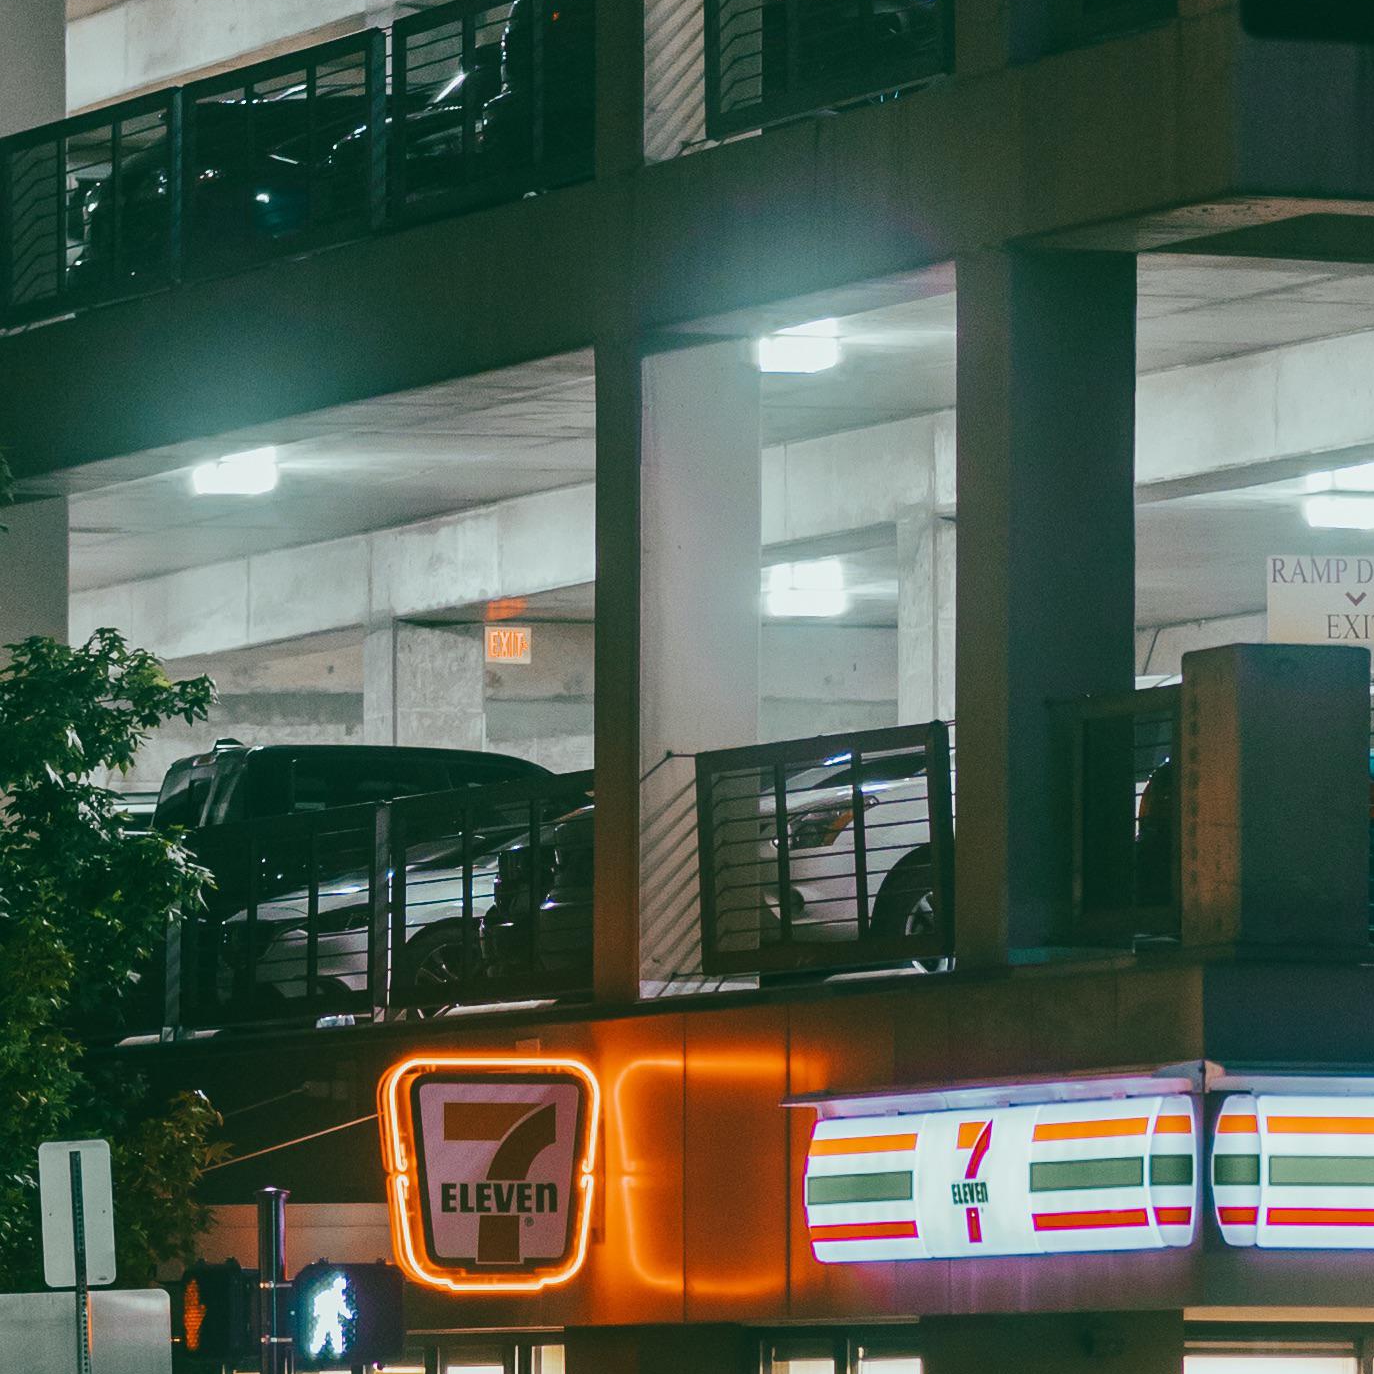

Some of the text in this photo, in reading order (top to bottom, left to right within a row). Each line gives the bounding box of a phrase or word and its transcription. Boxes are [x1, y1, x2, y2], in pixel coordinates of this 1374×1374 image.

[1271, 558, 1348, 584] RAMP
[488, 631, 524, 658] EXIT
[443, 1102, 557, 1263] 7
[957, 1119, 993, 1243] 7
